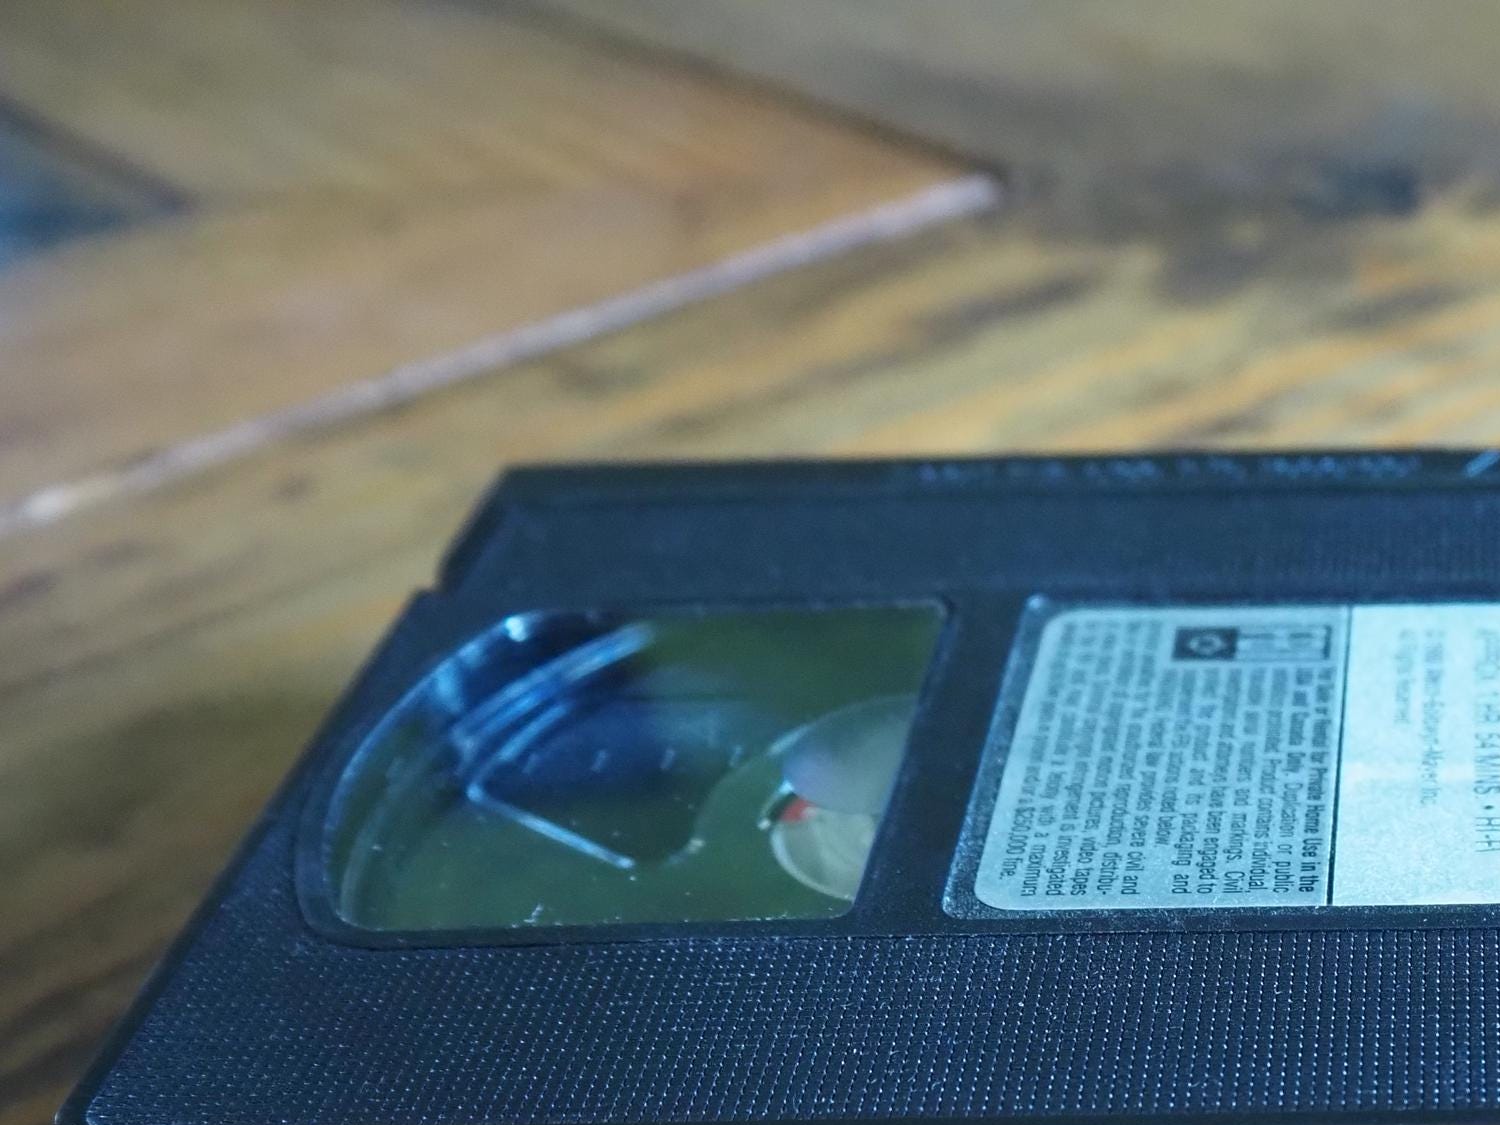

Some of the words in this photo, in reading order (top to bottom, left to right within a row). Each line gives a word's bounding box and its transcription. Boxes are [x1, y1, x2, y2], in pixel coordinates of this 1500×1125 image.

[1164, 751, 1186, 783] actions
[1258, 759, 1281, 794] Product
[1131, 771, 1160, 811] provides
[1184, 793, 1205, 804] its
[1209, 786, 1230, 807] have
[1232, 788, 1254, 806] and
[1306, 767, 1327, 800] Private
[1080, 791, 1108, 832] pictures,
[1159, 786, 1181, 812] noted
[1275, 782, 1303, 837] Duplication
[1037, 804, 1058, 825] with
[1057, 823, 1078, 832] is
[1100, 784, 1133, 847] reproduction,
[1205, 811, 1227, 833] been
[1253, 797, 1277, 839] contains
[1303, 804, 1325, 834] Home
[1004, 807, 1034, 855] $250,000
[1128, 815, 1148, 846] severe
[1153, 815, 1177, 847] below.
[1171, 812, 1201, 865] packaging
[1221, 813, 1251, 863] markings.
[1076, 836, 1100, 863] video
[1124, 851, 1147, 870] civil
[1194, 837, 1223, 880] engaged
[1301, 837, 1322, 857] Use
[998, 857, 1023, 879] fine.
[1020, 844, 1049, 896] maximum
[1040, 835, 1076, 896] investigated
[1095, 852, 1122, 895] distribu-
[1245, 841, 1272, 893] individual,
[1269, 861, 1296, 893] public
[1300, 861, 1320, 871] in
[1067, 867, 1094, 895] tapes
[1120, 875, 1143, 894] and
[1171, 874, 1193, 894] and
[1197, 883, 1218, 894] to
[1221, 871, 1245, 893] Civil
[1298, 875, 1319, 892] the
